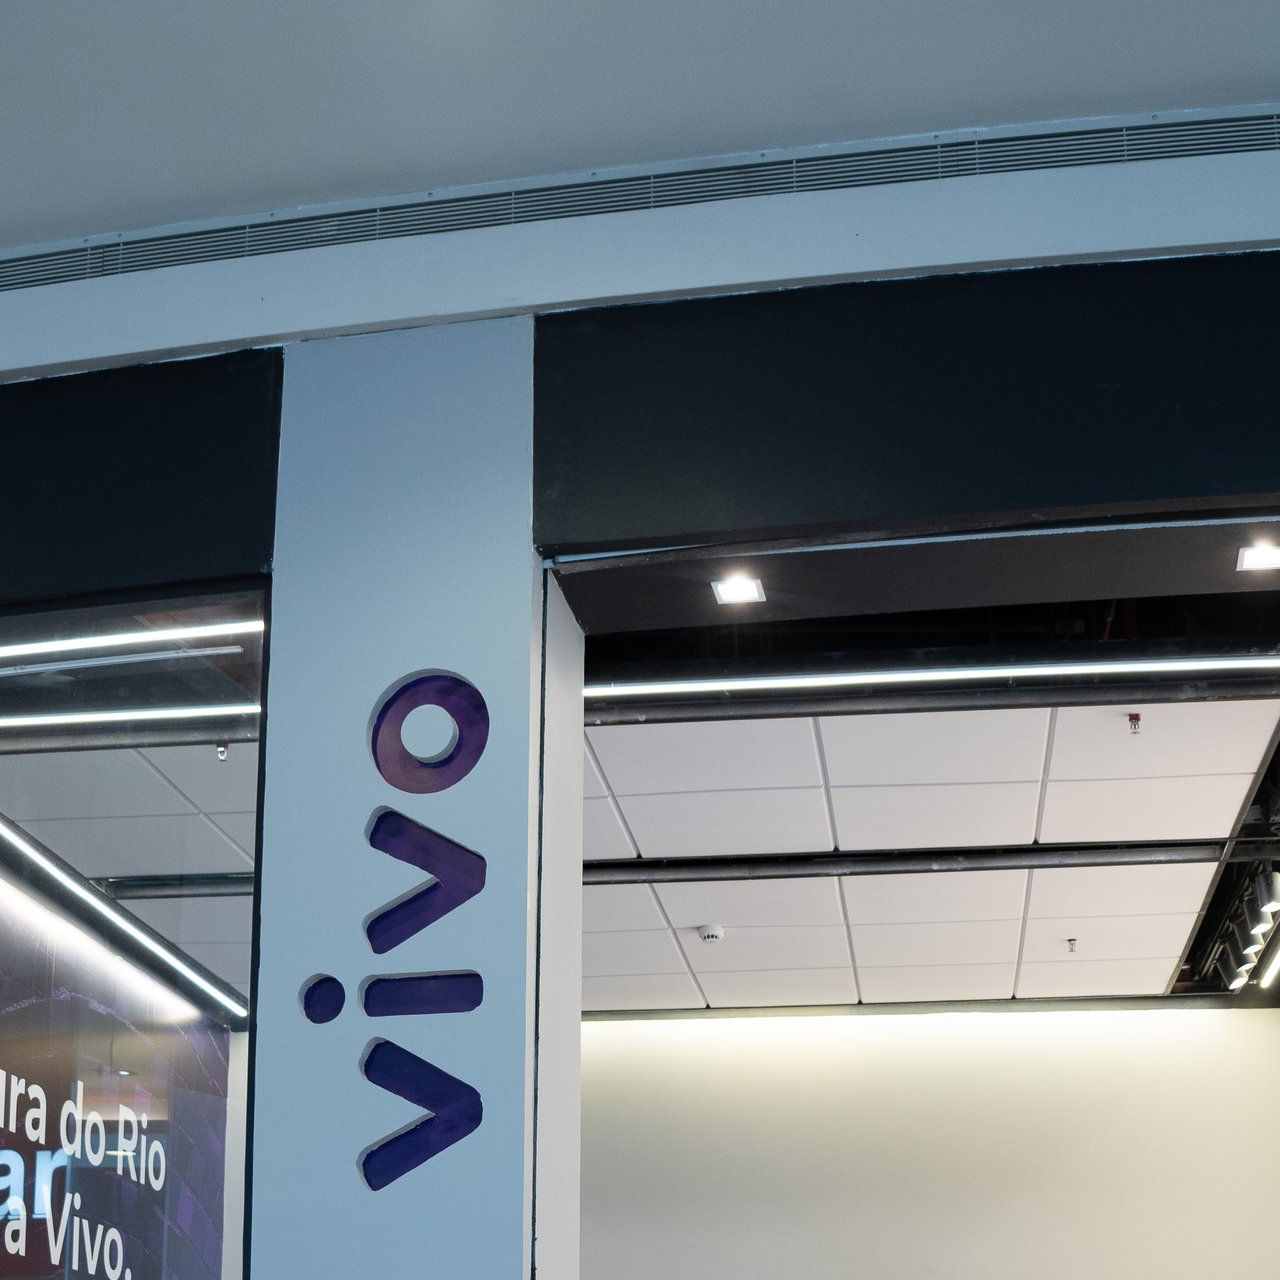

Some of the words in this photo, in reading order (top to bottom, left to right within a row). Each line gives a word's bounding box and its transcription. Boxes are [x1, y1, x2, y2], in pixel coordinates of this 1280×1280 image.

[302, 670, 489, 1192] vivo
[60, 1080, 106, 1166] do
[118, 1103, 166, 1191] Rio
